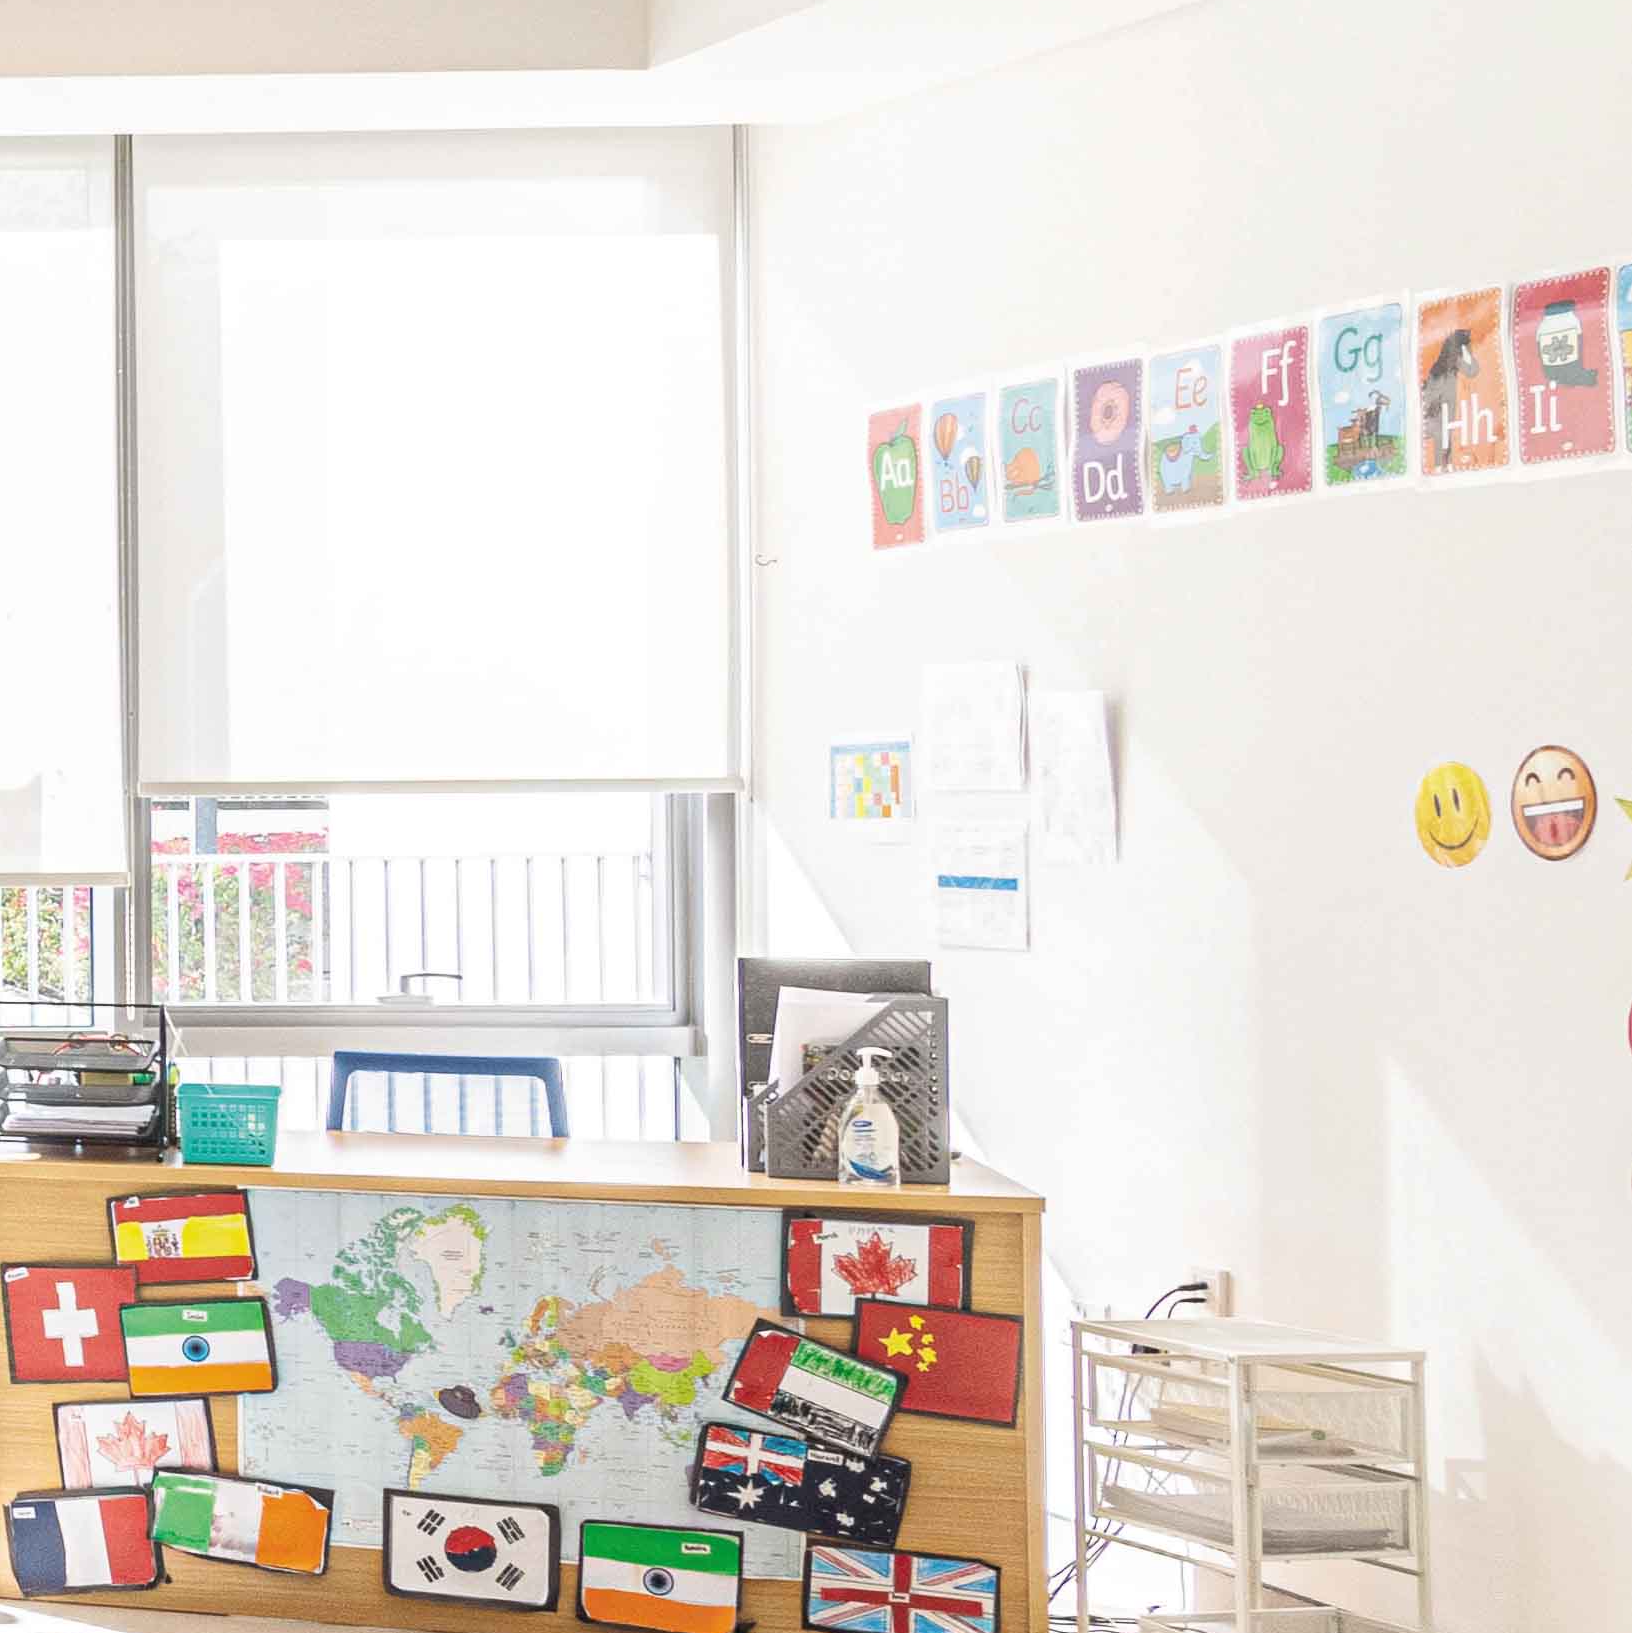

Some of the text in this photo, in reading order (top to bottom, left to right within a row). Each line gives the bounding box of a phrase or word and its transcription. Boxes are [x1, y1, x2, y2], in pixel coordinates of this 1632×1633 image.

[1260, 339, 1298, 408] Ff
[1334, 326, 1384, 384] Gg
[1174, 367, 1208, 411] Ee
[1529, 380, 1563, 435] Ii
[1010, 397, 1043, 435] Cc
[1441, 393, 1498, 451] Hh
[879, 451, 914, 491] Aa
[938, 470, 970, 513] Bb
[1082, 451, 1128, 504] Dd
